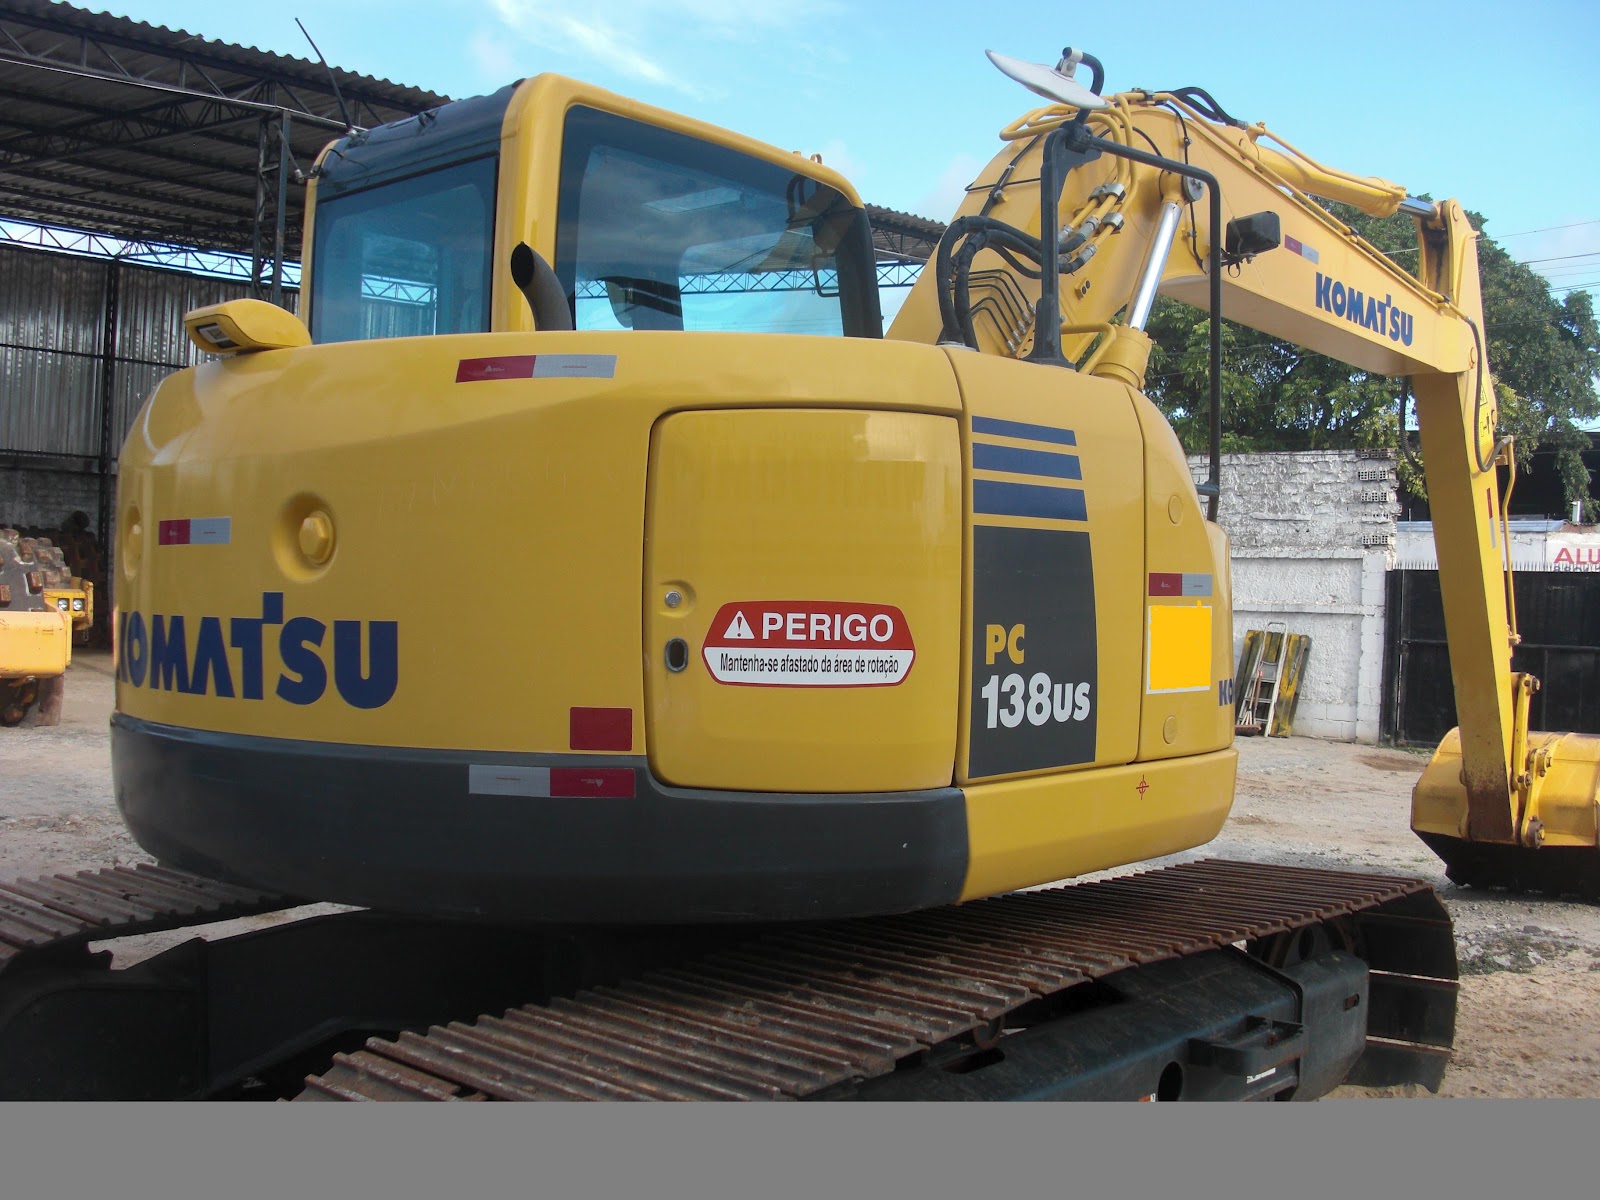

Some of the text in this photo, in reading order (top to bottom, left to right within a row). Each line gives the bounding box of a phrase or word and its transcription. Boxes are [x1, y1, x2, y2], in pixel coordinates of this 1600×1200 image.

[1315, 271, 1413, 347] KOMATSU
[762, 612, 894, 642] PERIGO
[985, 623, 1025, 665] PC
[720, 653, 899, 678] Mantenha-se afastado da área de rotação
